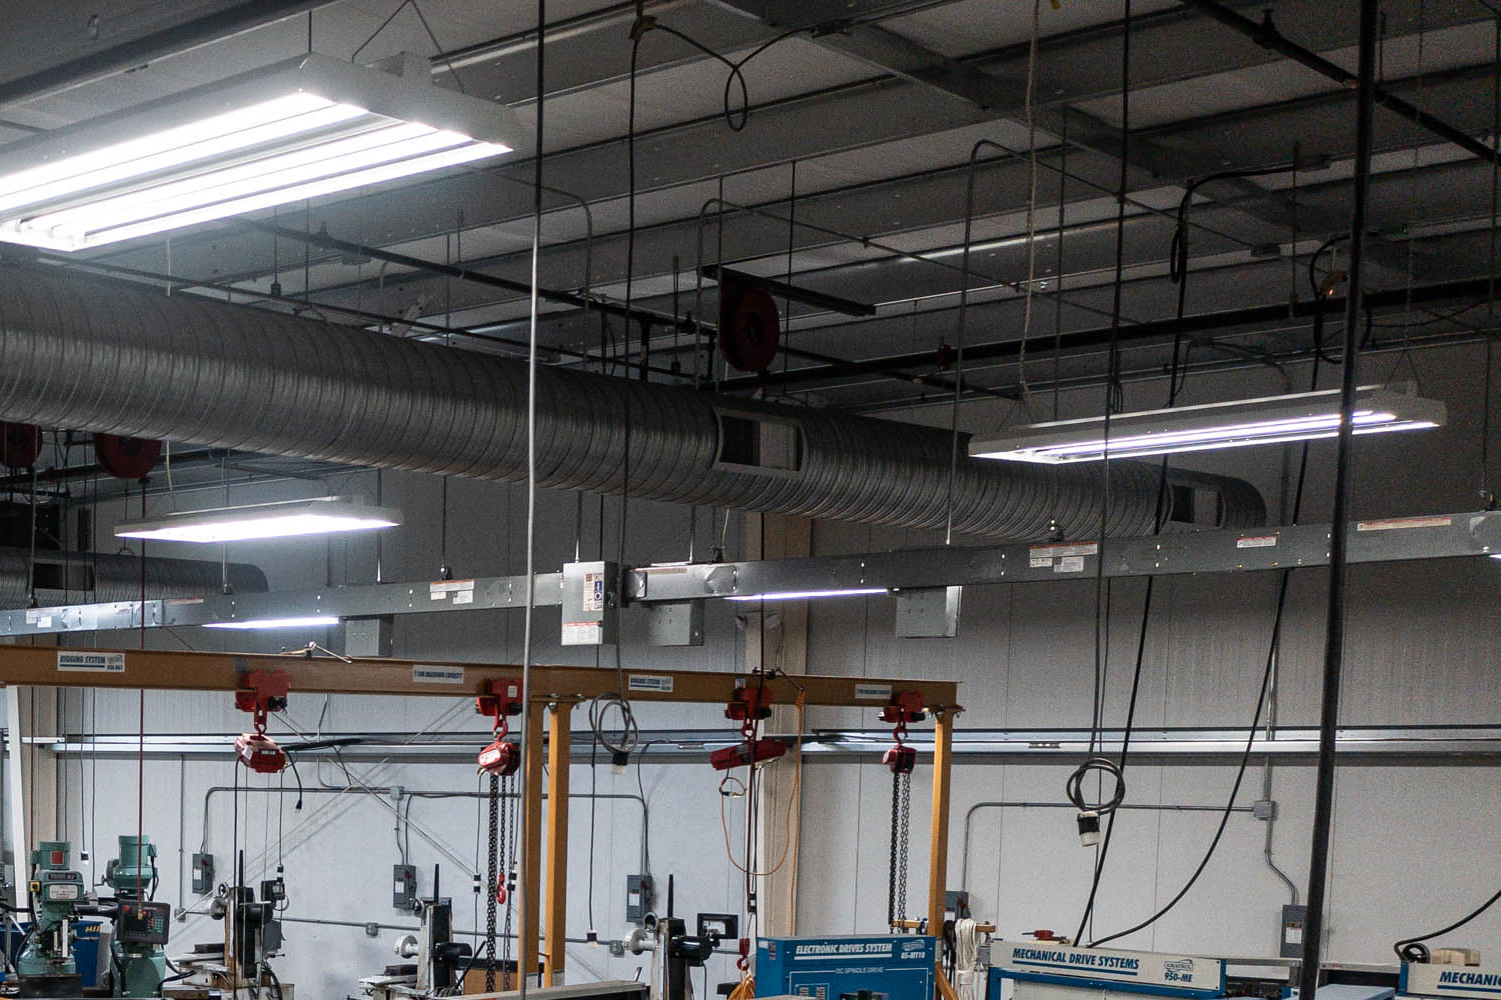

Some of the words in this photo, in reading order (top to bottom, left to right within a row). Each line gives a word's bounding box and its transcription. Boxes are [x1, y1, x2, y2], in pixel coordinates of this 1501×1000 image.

[795, 944, 838, 954] ELECTRONIC
[839, 943, 864, 953] DRIVES
[865, 943, 892, 952] SYSTEM
[1013, 948, 1066, 963] MECHANICAL
[1069, 954, 1096, 966] DRIVE
[1098, 956, 1139, 970] SYSTEMS
